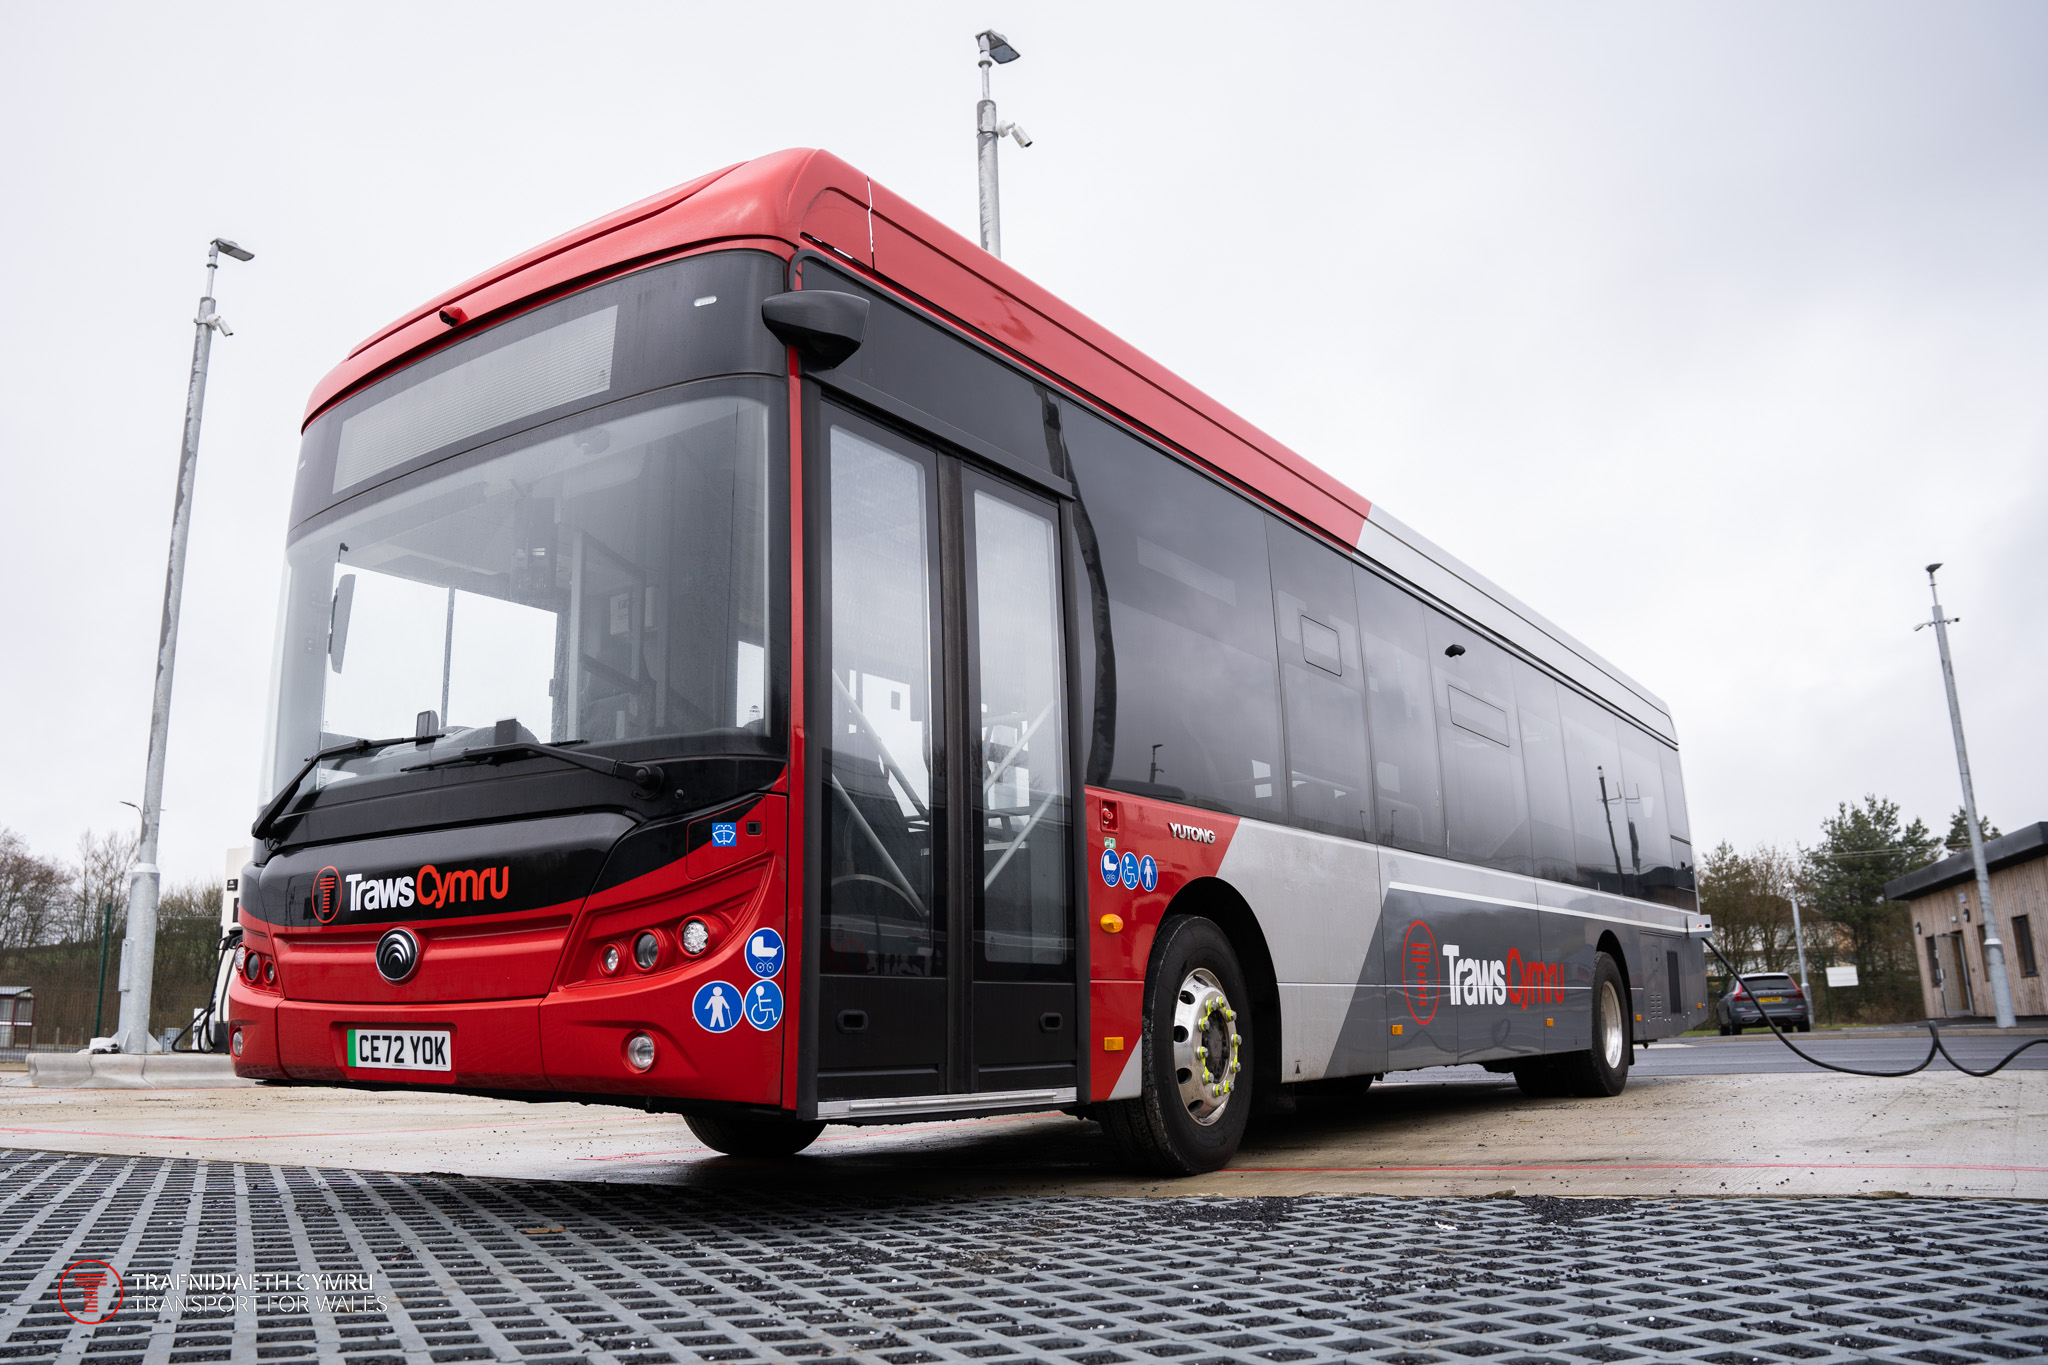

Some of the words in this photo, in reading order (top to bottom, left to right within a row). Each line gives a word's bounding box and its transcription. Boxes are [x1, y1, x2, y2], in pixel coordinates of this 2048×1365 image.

[1167, 822, 1216, 844] YUTONG
[345, 864, 509, 911] TrawsCymru
[359, 1034, 405, 1063] CE72
[409, 1035, 447, 1065] YOK
